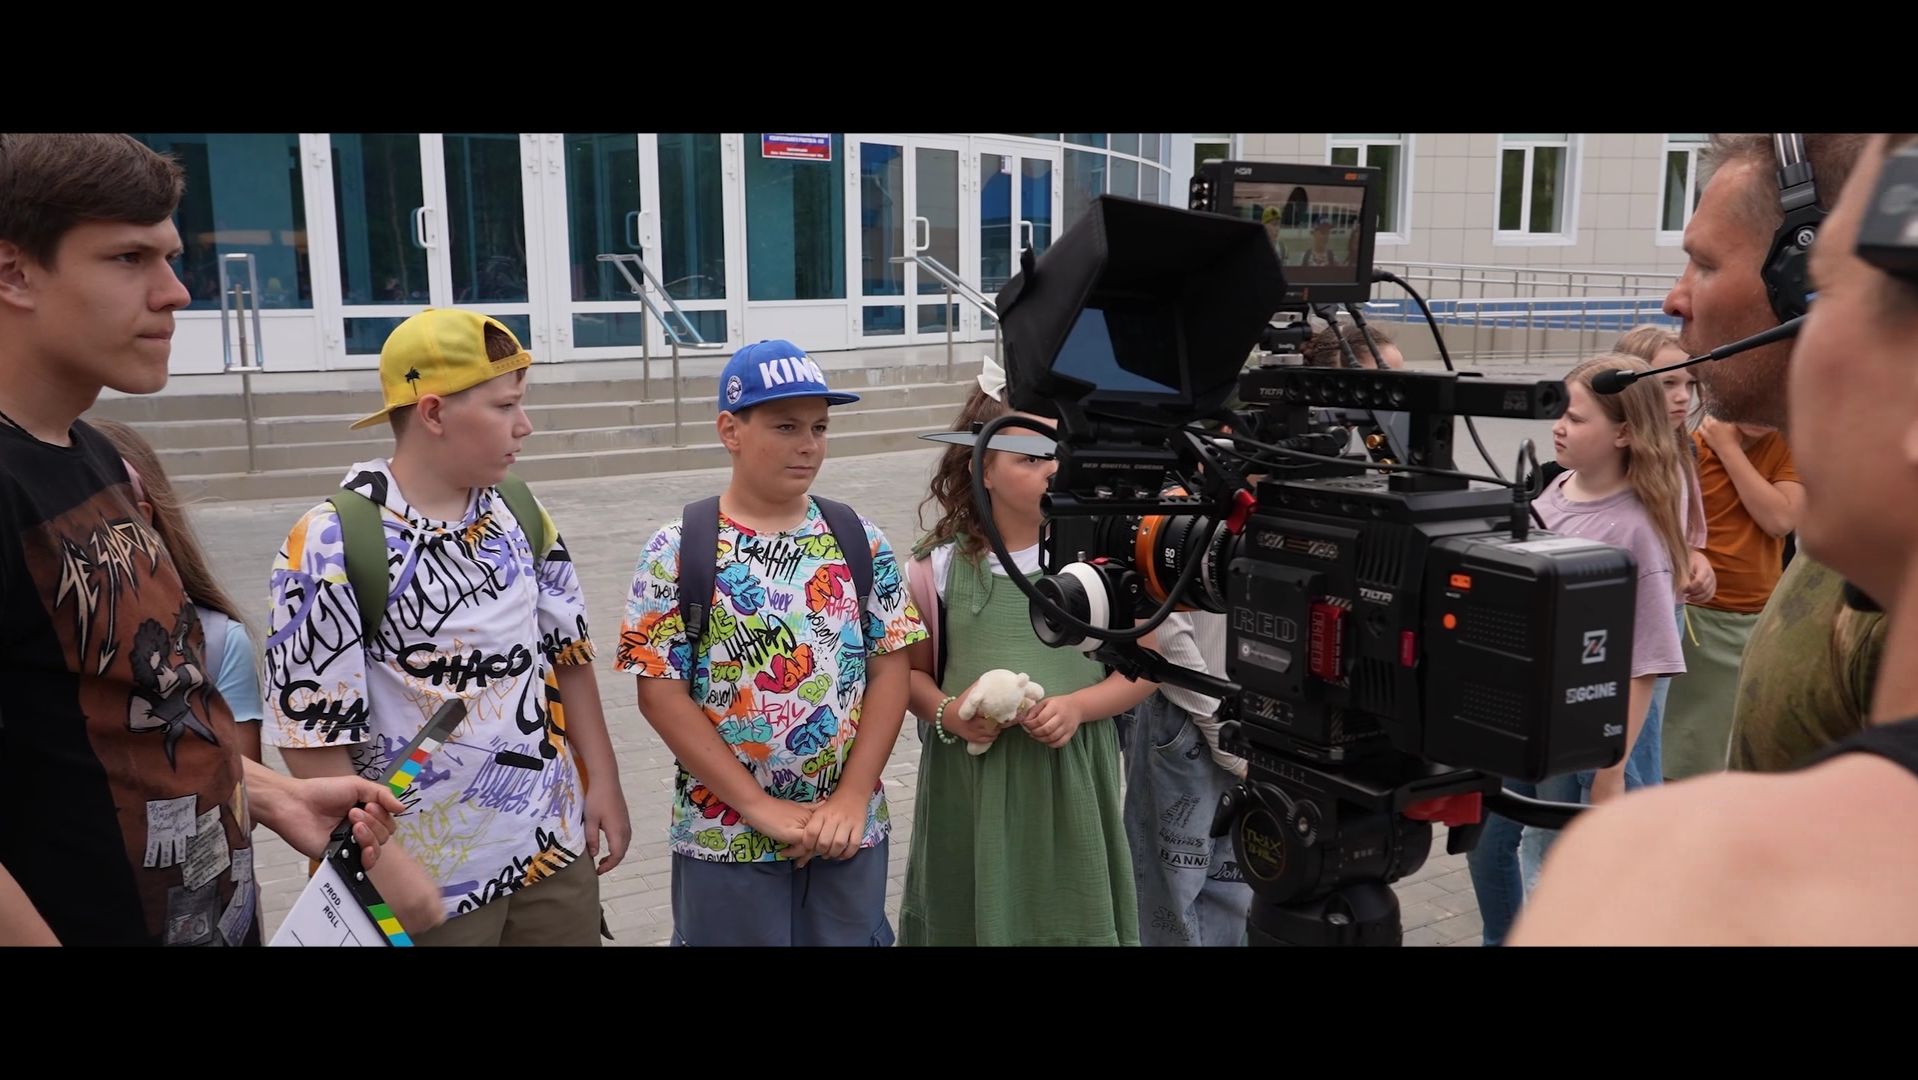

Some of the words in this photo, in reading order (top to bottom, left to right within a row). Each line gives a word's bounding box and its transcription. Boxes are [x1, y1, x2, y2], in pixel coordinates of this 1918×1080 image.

[759, 356, 827, 390] KING
[1165, 547, 1176, 559] 50
[1359, 587, 1393, 603] TILTA
[1233, 606, 1297, 643] RED
[322, 905, 339, 928] ROLL
